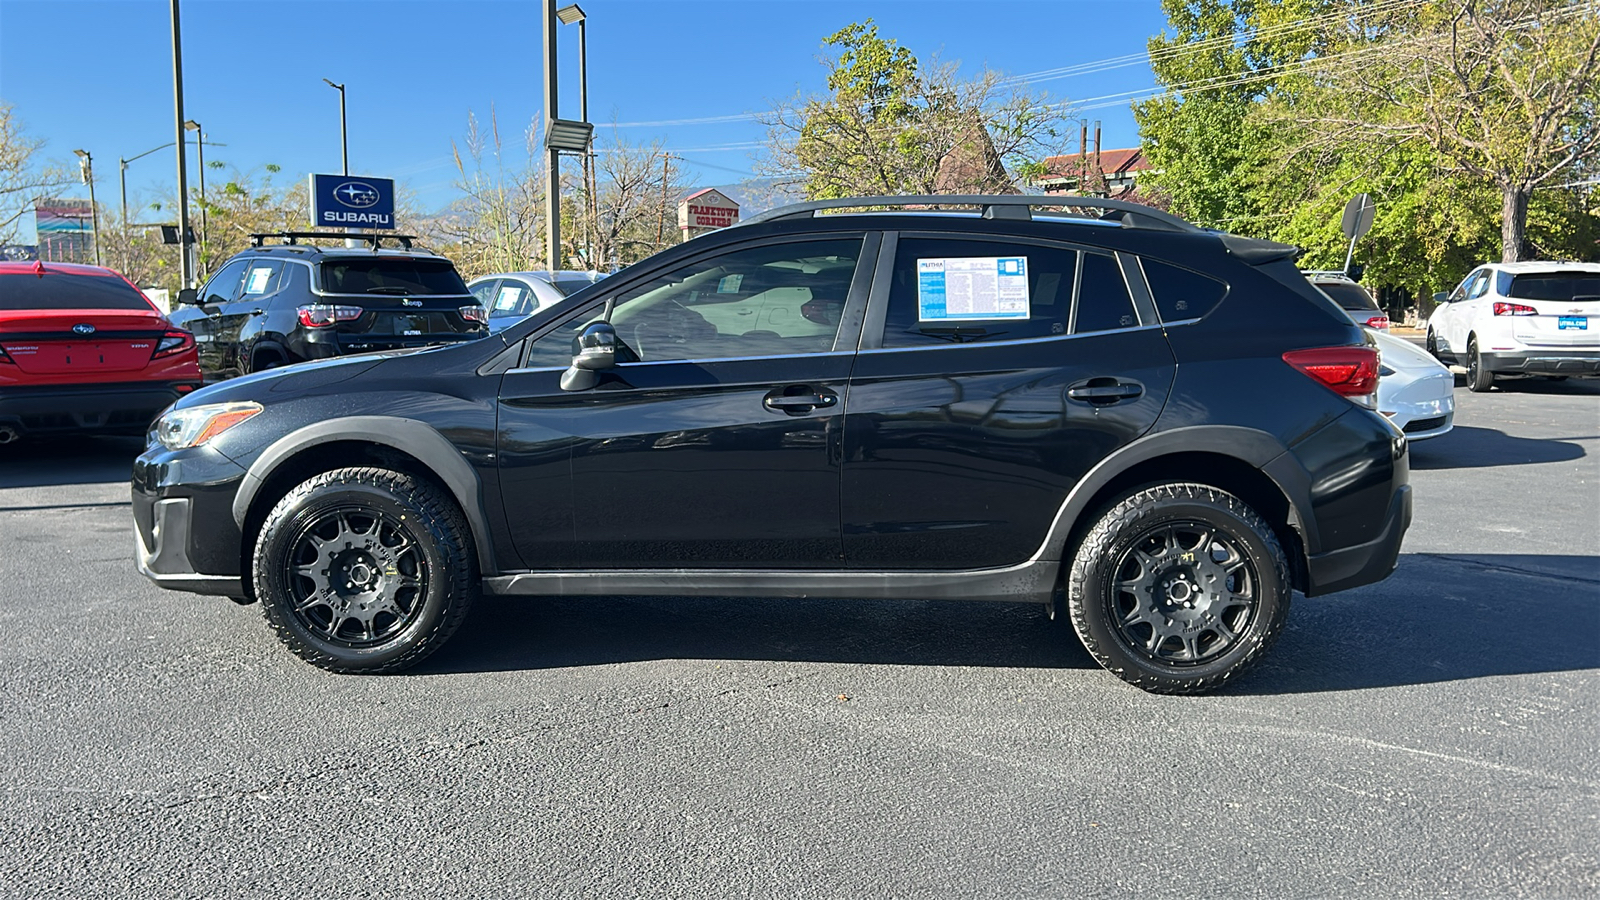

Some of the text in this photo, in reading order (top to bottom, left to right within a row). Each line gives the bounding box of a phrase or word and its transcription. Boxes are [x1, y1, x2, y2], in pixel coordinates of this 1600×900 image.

[689, 205, 738, 217] FRANKTOWN
[323, 211, 389, 224] SUBARU
[696, 216, 731, 227] CORNERS
[402, 298, 423, 307] Jeep
